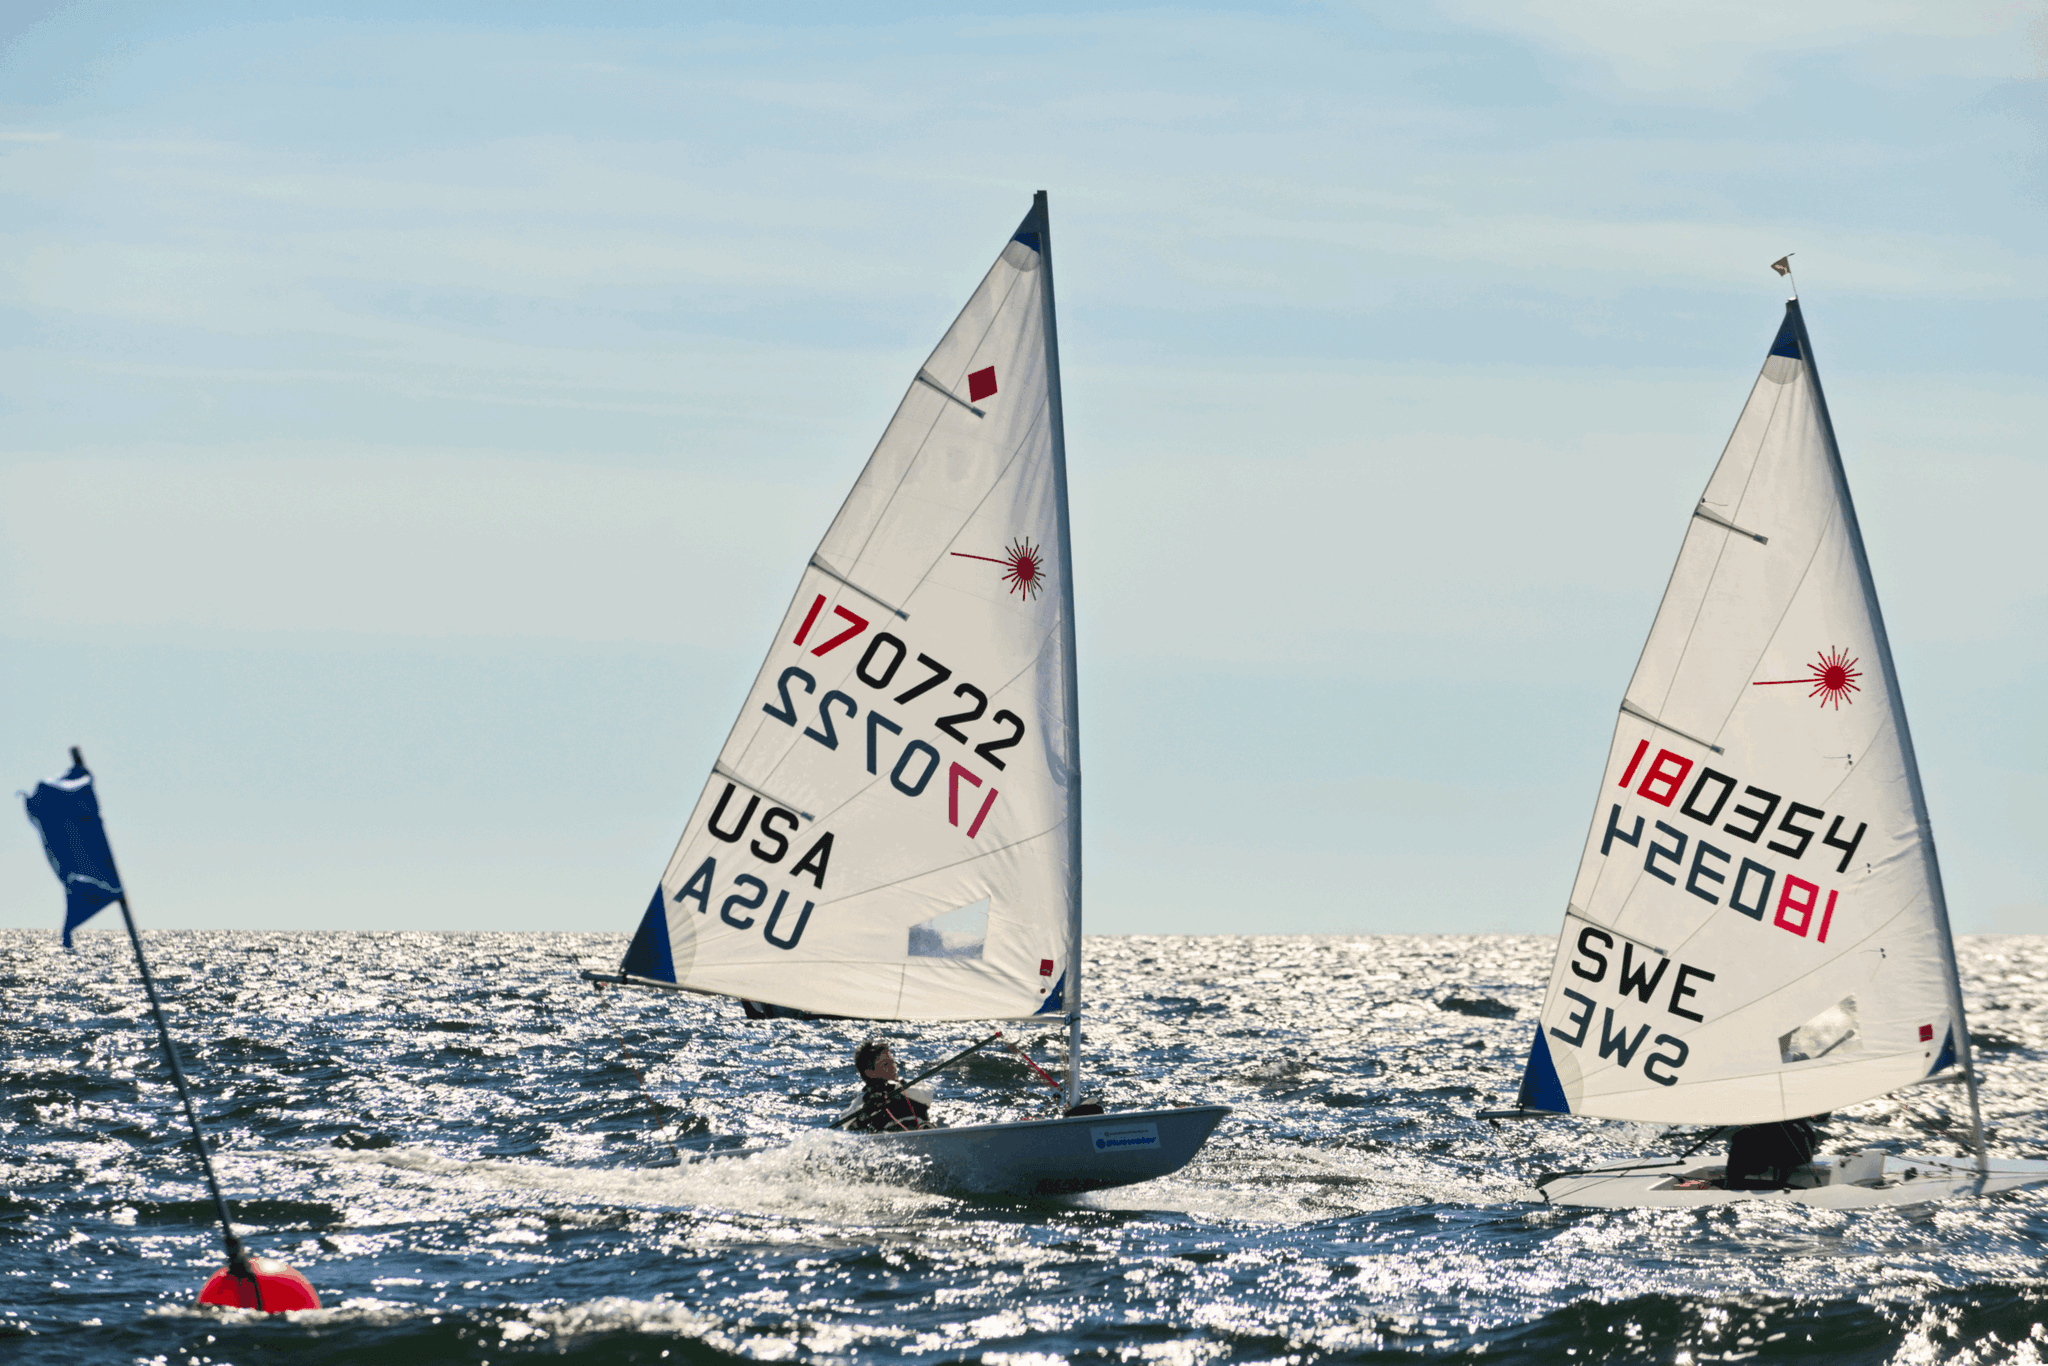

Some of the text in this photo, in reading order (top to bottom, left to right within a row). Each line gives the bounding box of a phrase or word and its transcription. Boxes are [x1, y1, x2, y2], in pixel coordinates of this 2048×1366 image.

[792, 593, 1025, 771] 170722
[707, 782, 835, 890] USA
[1618, 739, 1868, 873] 180354
[1571, 926, 1716, 1023] SWE
